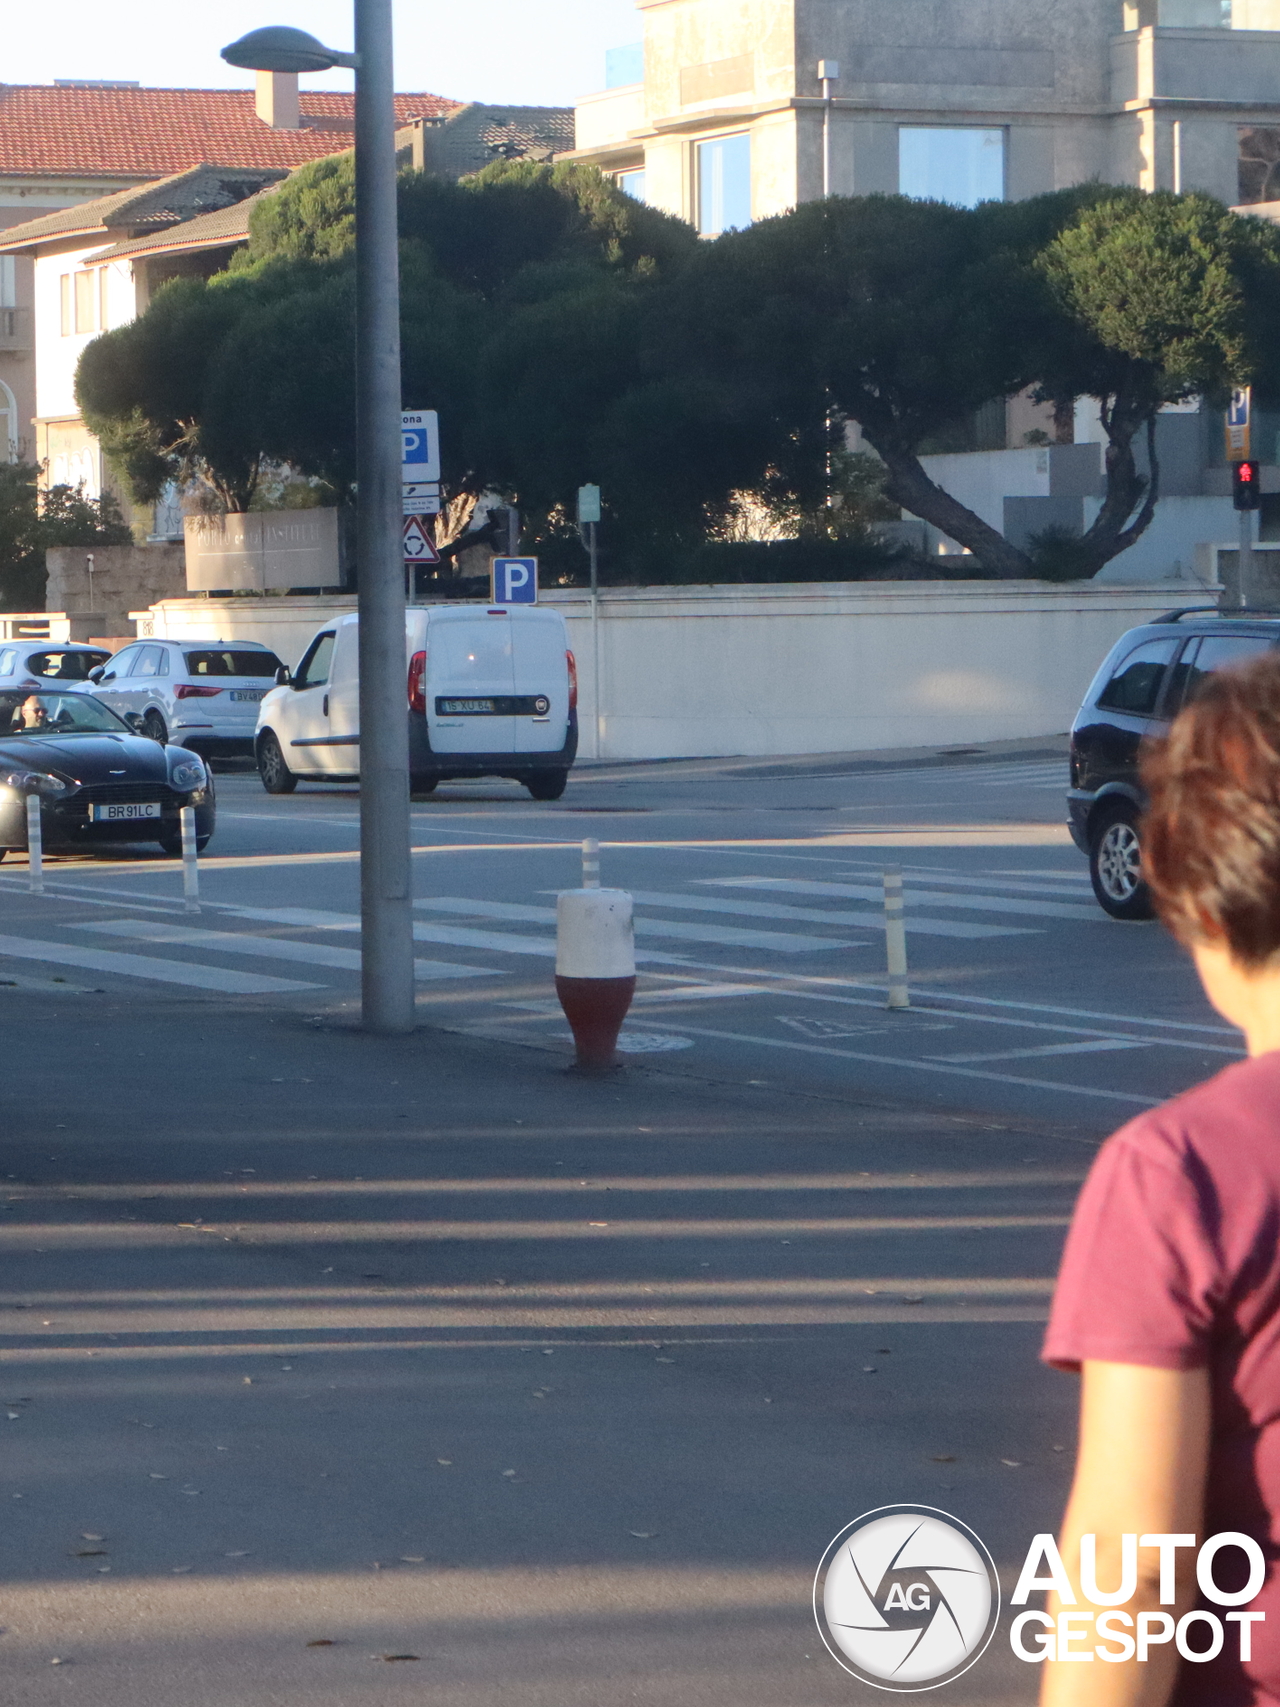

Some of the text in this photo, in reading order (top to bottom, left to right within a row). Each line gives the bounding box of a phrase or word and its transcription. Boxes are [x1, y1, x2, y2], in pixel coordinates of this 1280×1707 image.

[401, 416, 422, 424] ona
[402, 433, 420, 460] P
[505, 563, 529, 600] P
